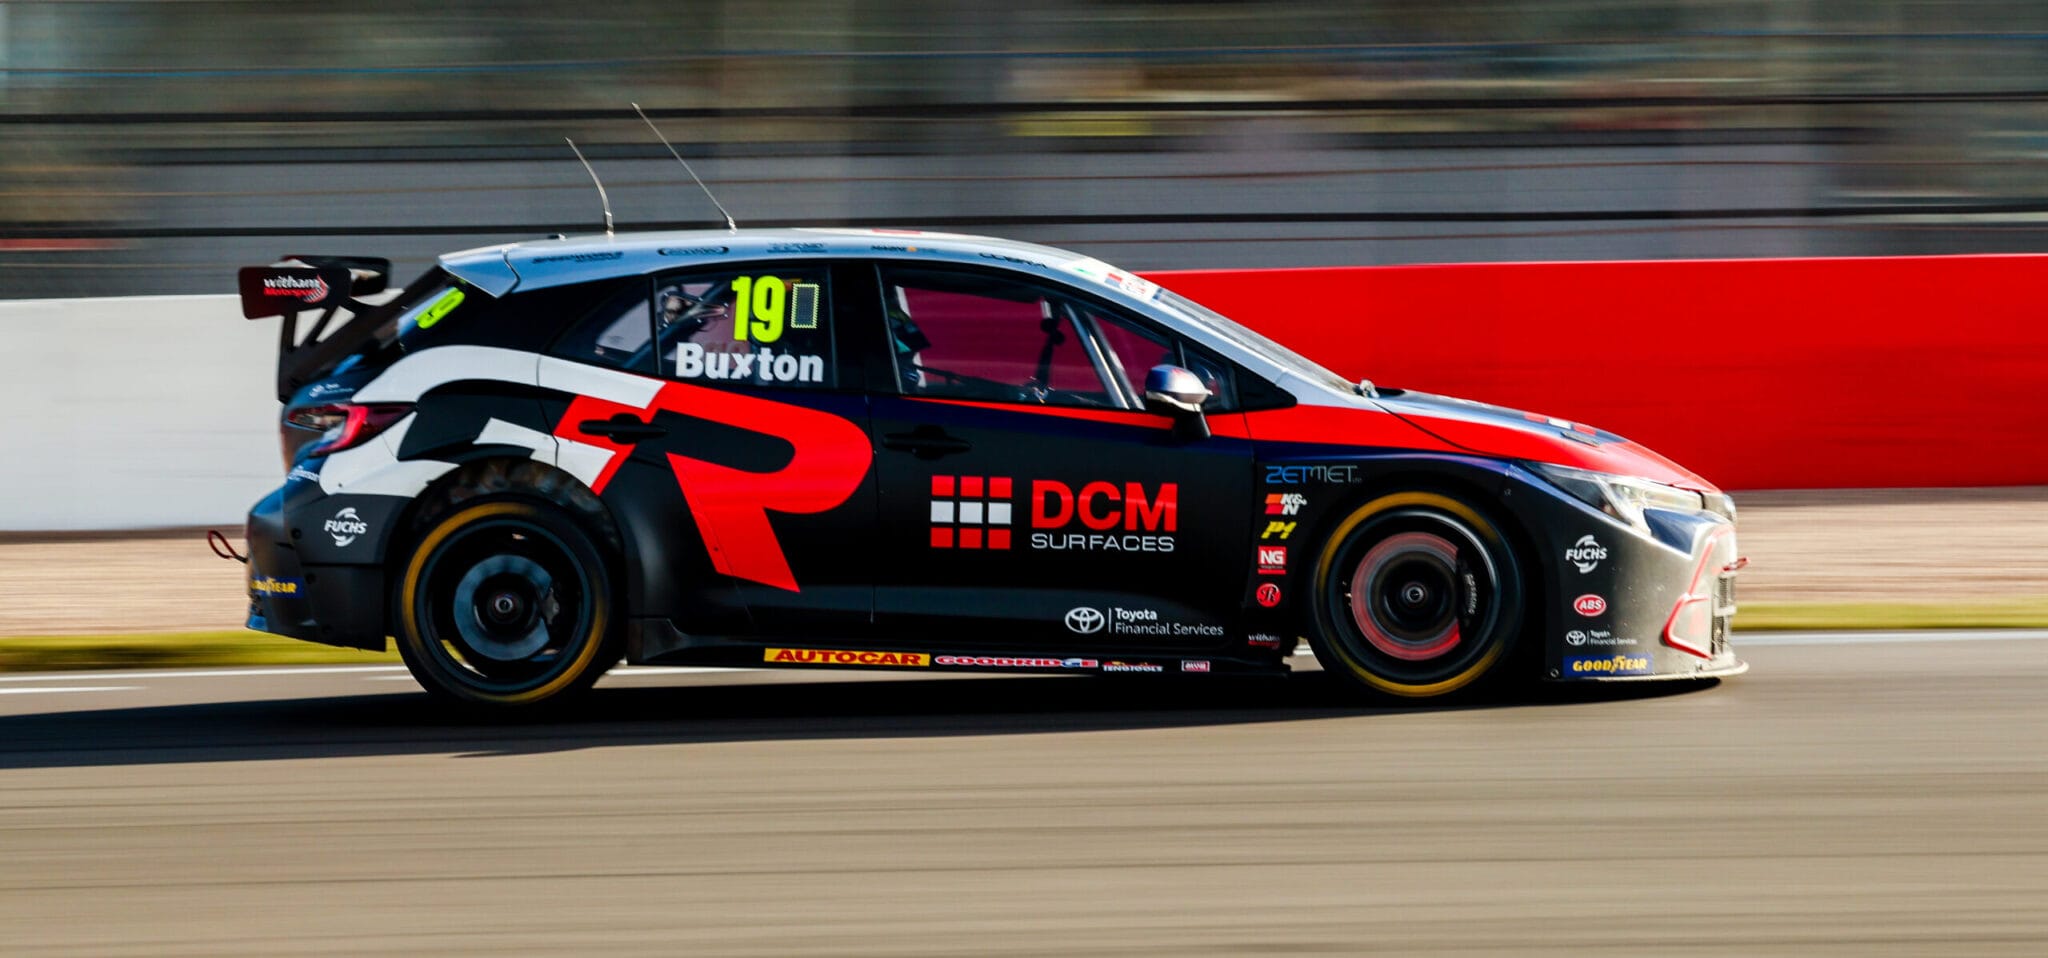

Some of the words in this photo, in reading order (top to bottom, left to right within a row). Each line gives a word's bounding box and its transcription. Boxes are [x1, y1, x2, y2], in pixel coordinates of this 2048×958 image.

[263, 275, 321, 289] witham
[731, 275, 786, 342] 19
[675, 342, 824, 382] Buxton
[1265, 465, 1358, 484] ZETMET
[1031, 479, 1178, 532] DCM
[323, 519, 368, 535] FUCHS
[1031, 533, 1175, 552] SURFACES
[1260, 549, 1286, 565] NG
[1565, 547, 1608, 561] FUCHS
[1580, 599, 1603, 611] ABS
[1114, 607, 1158, 622] Toyota
[1115, 622, 1171, 635] Financial
[1173, 622, 1224, 636] Services
[774, 649, 922, 666] AUTOCAR
[934, 655, 1099, 669] GOODRIDGE
[1572, 655, 1648, 674] GOODYEAR
